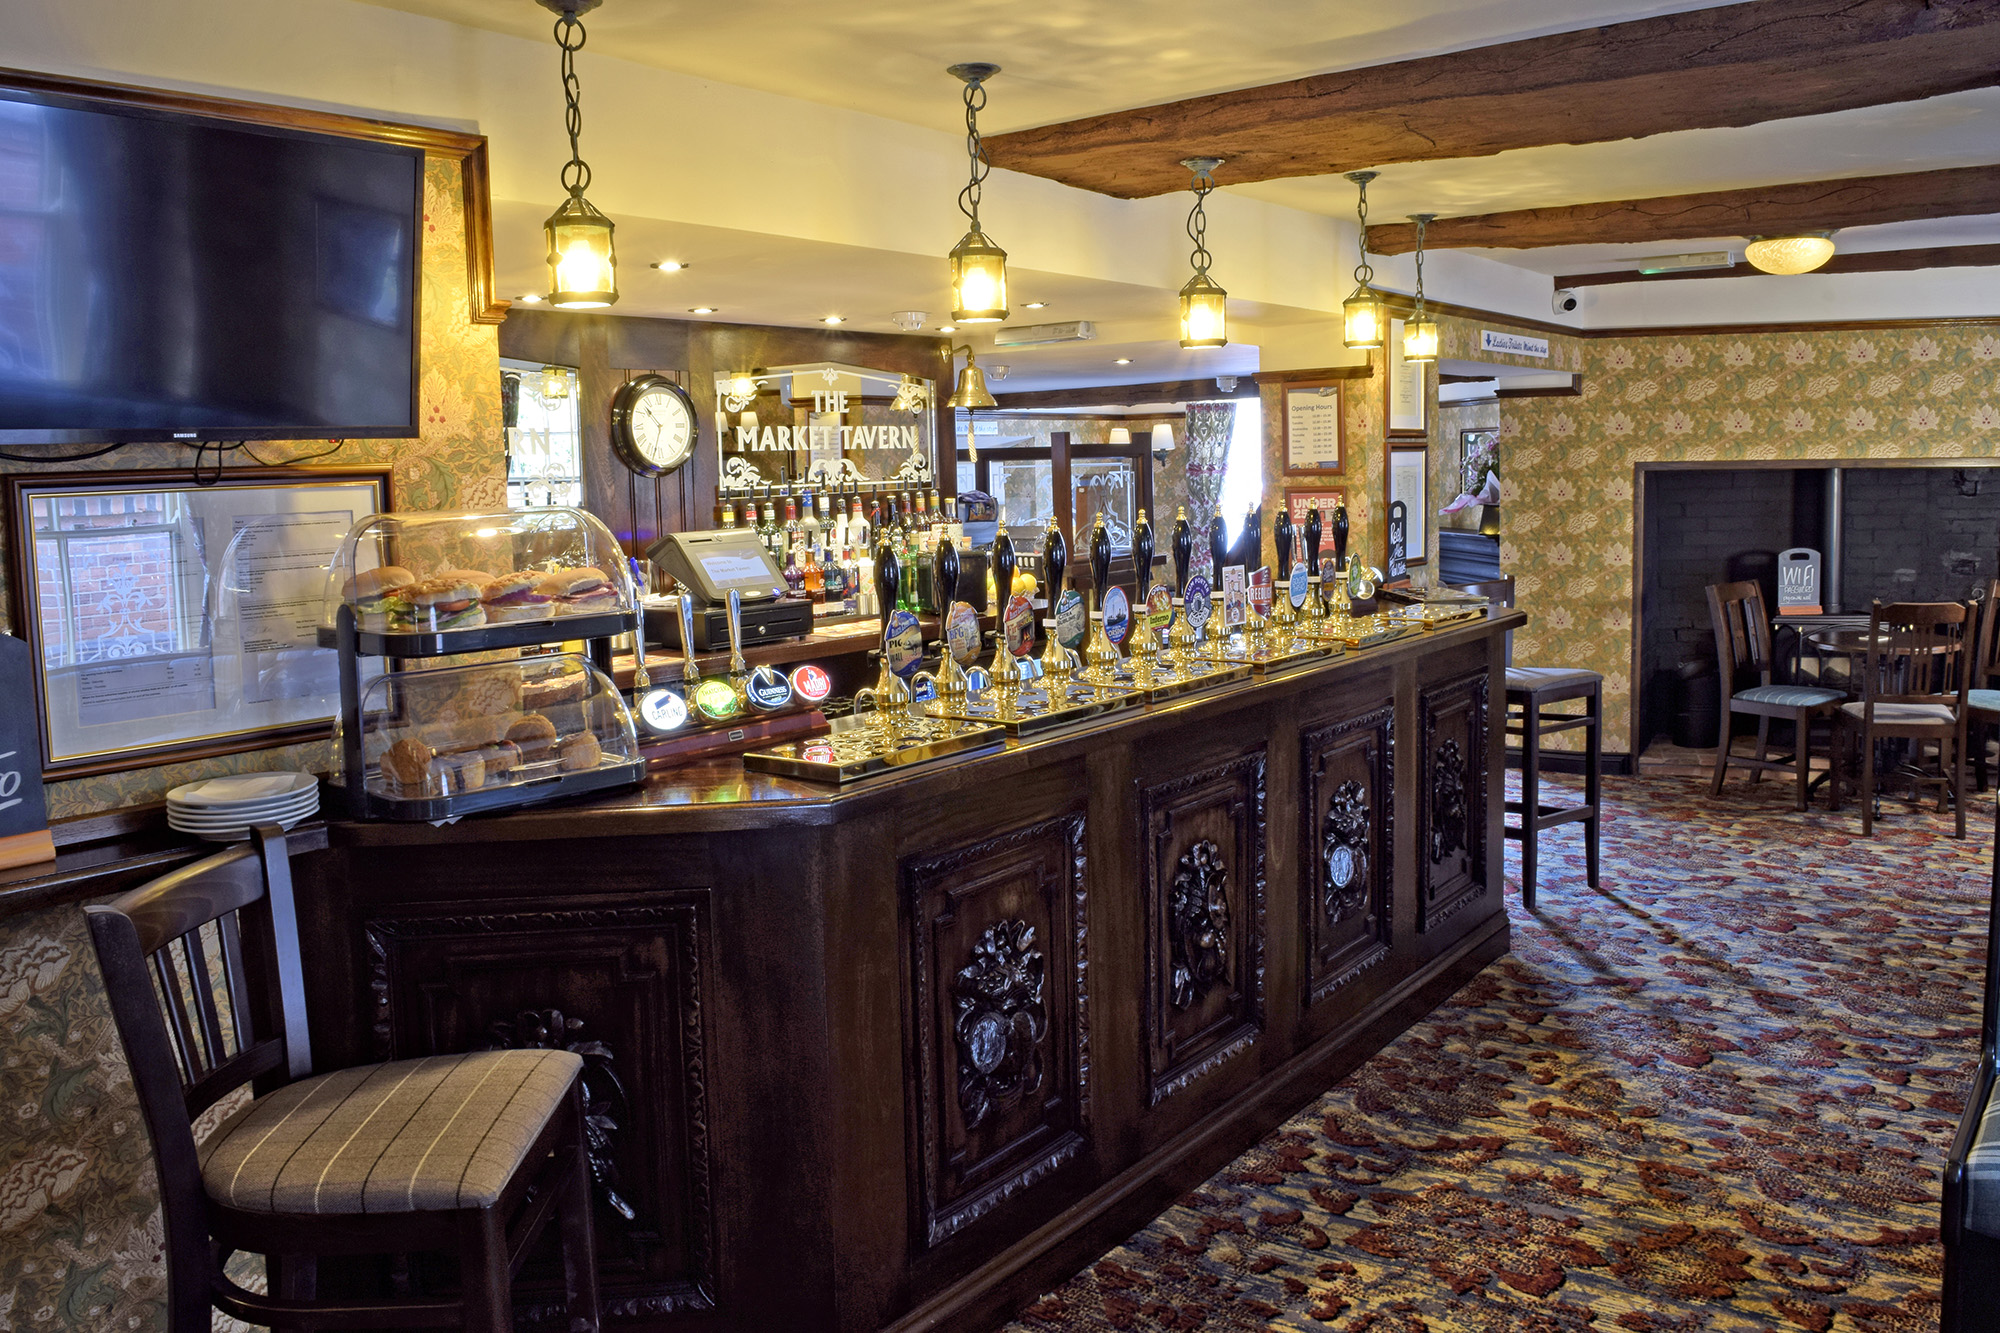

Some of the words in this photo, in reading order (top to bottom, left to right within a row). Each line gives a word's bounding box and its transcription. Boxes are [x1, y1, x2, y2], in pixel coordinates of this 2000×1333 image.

[811, 389, 850, 413] THE
[736, 425, 832, 452] MARKET
[841, 425, 915, 450] TAVERN
[1185, 581, 1195, 601] PLUM
[1194, 577, 1210, 593] PORTER
[1150, 614, 1169, 624] Inferno
[889, 639, 902, 648] PIG
[701, 685, 730, 697] THATCHERS
[759, 686, 787, 697] GUINNESS
[652, 706, 683, 720] CARLING
